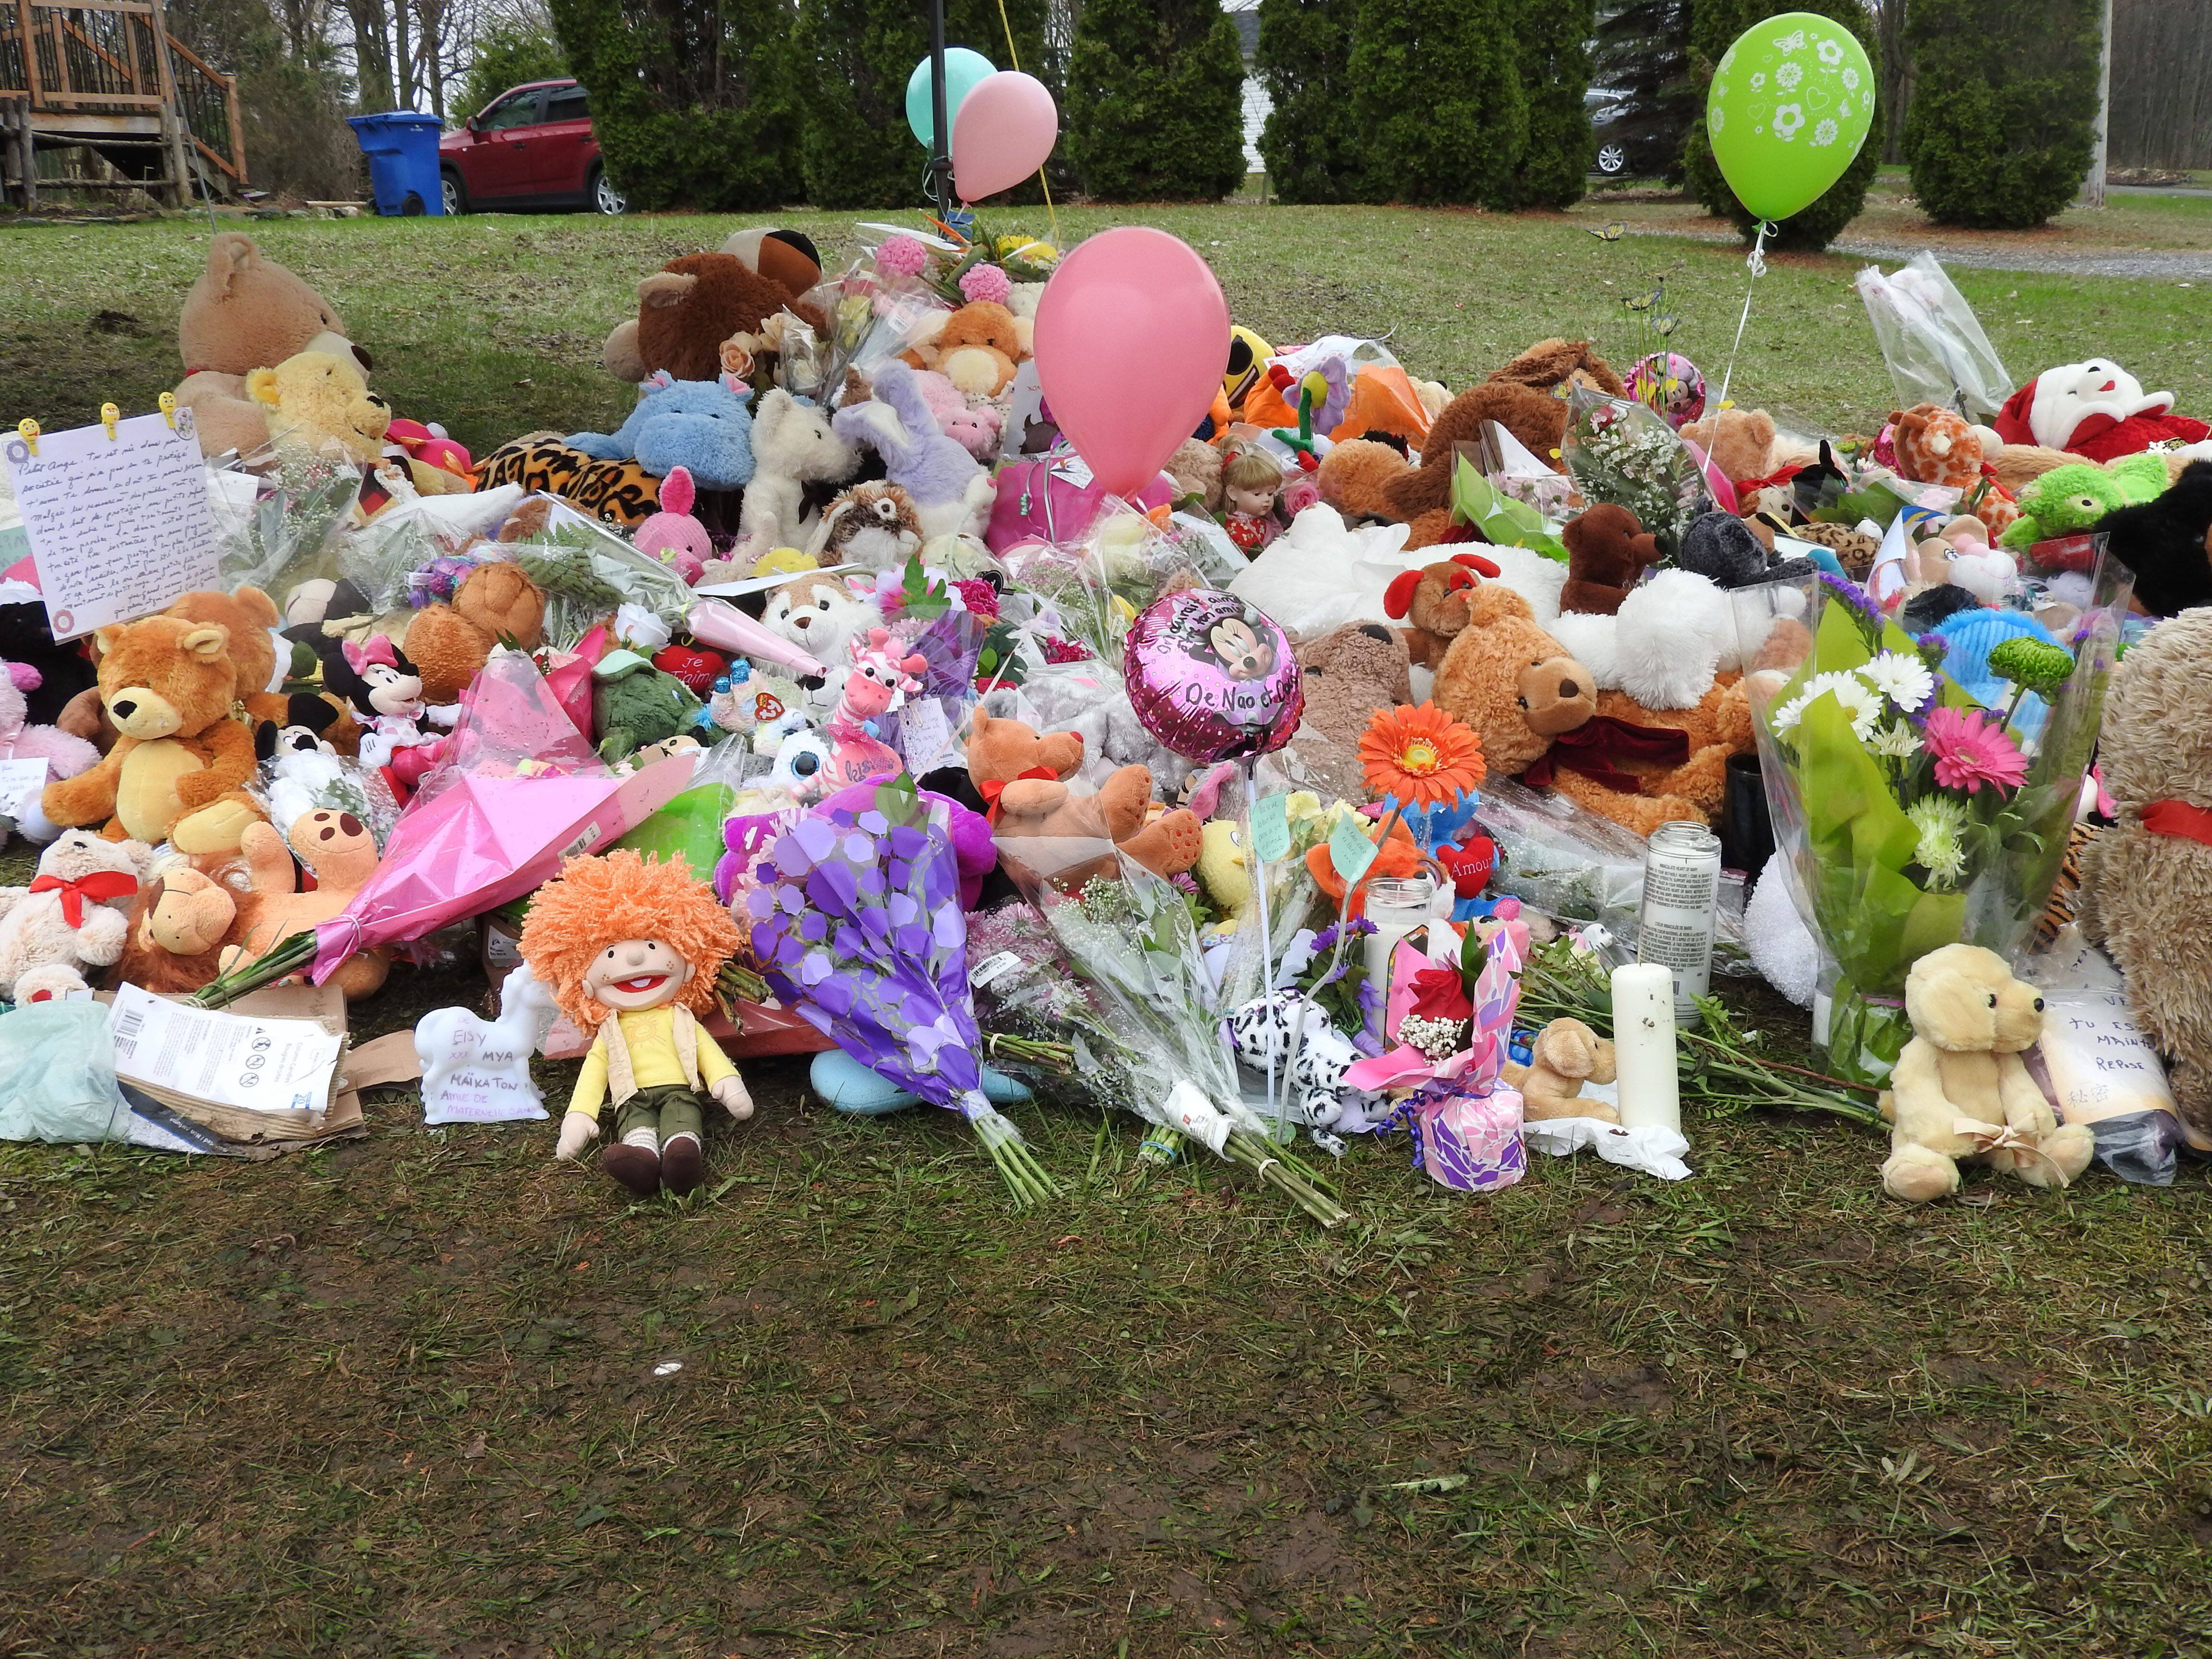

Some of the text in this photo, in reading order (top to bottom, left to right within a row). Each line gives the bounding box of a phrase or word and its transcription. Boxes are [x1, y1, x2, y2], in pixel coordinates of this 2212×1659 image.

[1192, 611, 1216, 625] ton
[682, 657, 704, 668] Je
[671, 670, 712, 685] T'aim
[1186, 682, 1215, 707] De
[1222, 686, 1255, 712] Nao
[1260, 685, 1274, 708] et
[759, 698, 782, 720] ty
[292, 1042, 303, 1062] Column
[482, 1051, 514, 1062] MYA
[2096, 1057, 2144, 1071] REPOSE
[285, 1062, 296, 1083] Candles
[297, 1094, 307, 1104] 20
[440, 1090, 489, 1104] AMIE DE
